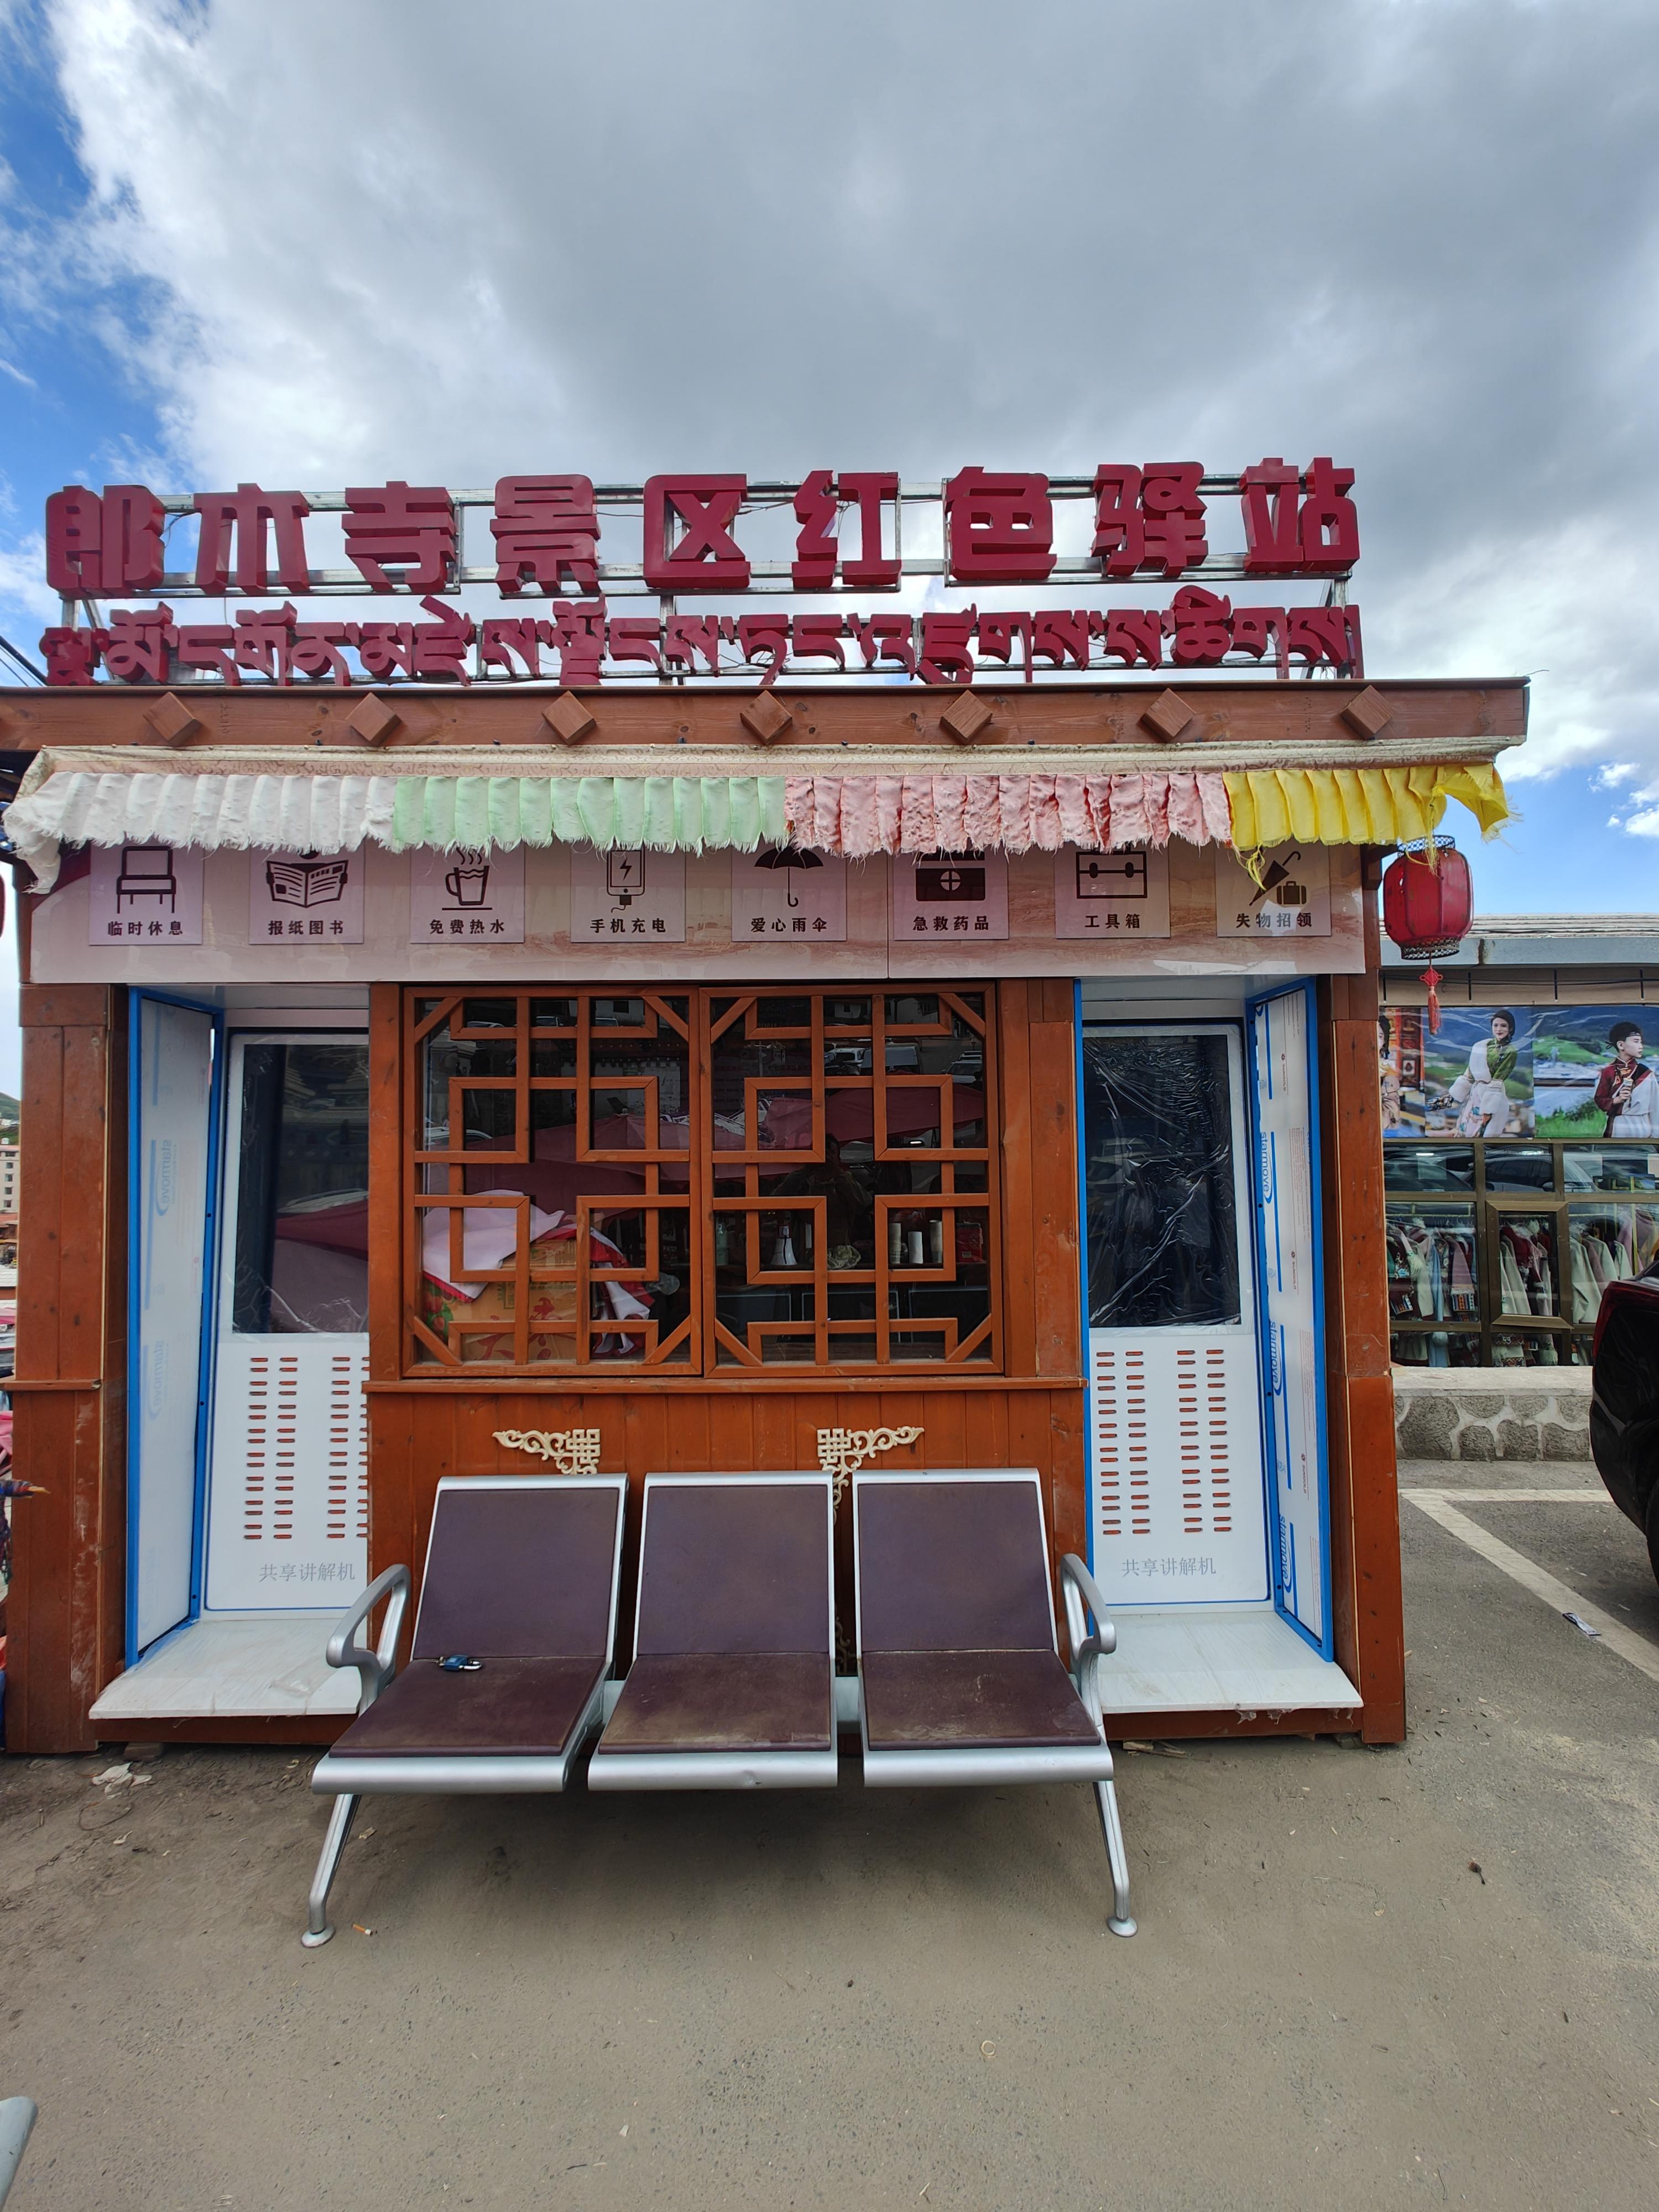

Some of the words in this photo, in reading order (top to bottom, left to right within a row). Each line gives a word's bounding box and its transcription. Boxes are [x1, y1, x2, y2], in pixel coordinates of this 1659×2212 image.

[46, 457, 1360, 598] 郎木寺景区红色驿站
[268, 920, 343, 935] 报纸图书
[430, 919, 505, 934] 免费热水
[590, 918, 666, 933] 手机充电
[751, 917, 827, 932] 爱心雨伞
[912, 916, 989, 931] 急救药品
[1084, 914, 1140, 928] 工具箱
[1236, 912, 1312, 928] 失物招领
[108, 921, 183, 936] 临时休息
[1260, 1132, 1270, 1192] starmove
[259, 1562, 355, 1582] 共享讲解机
[1121, 1557, 1216, 1577] 共享讲解机
